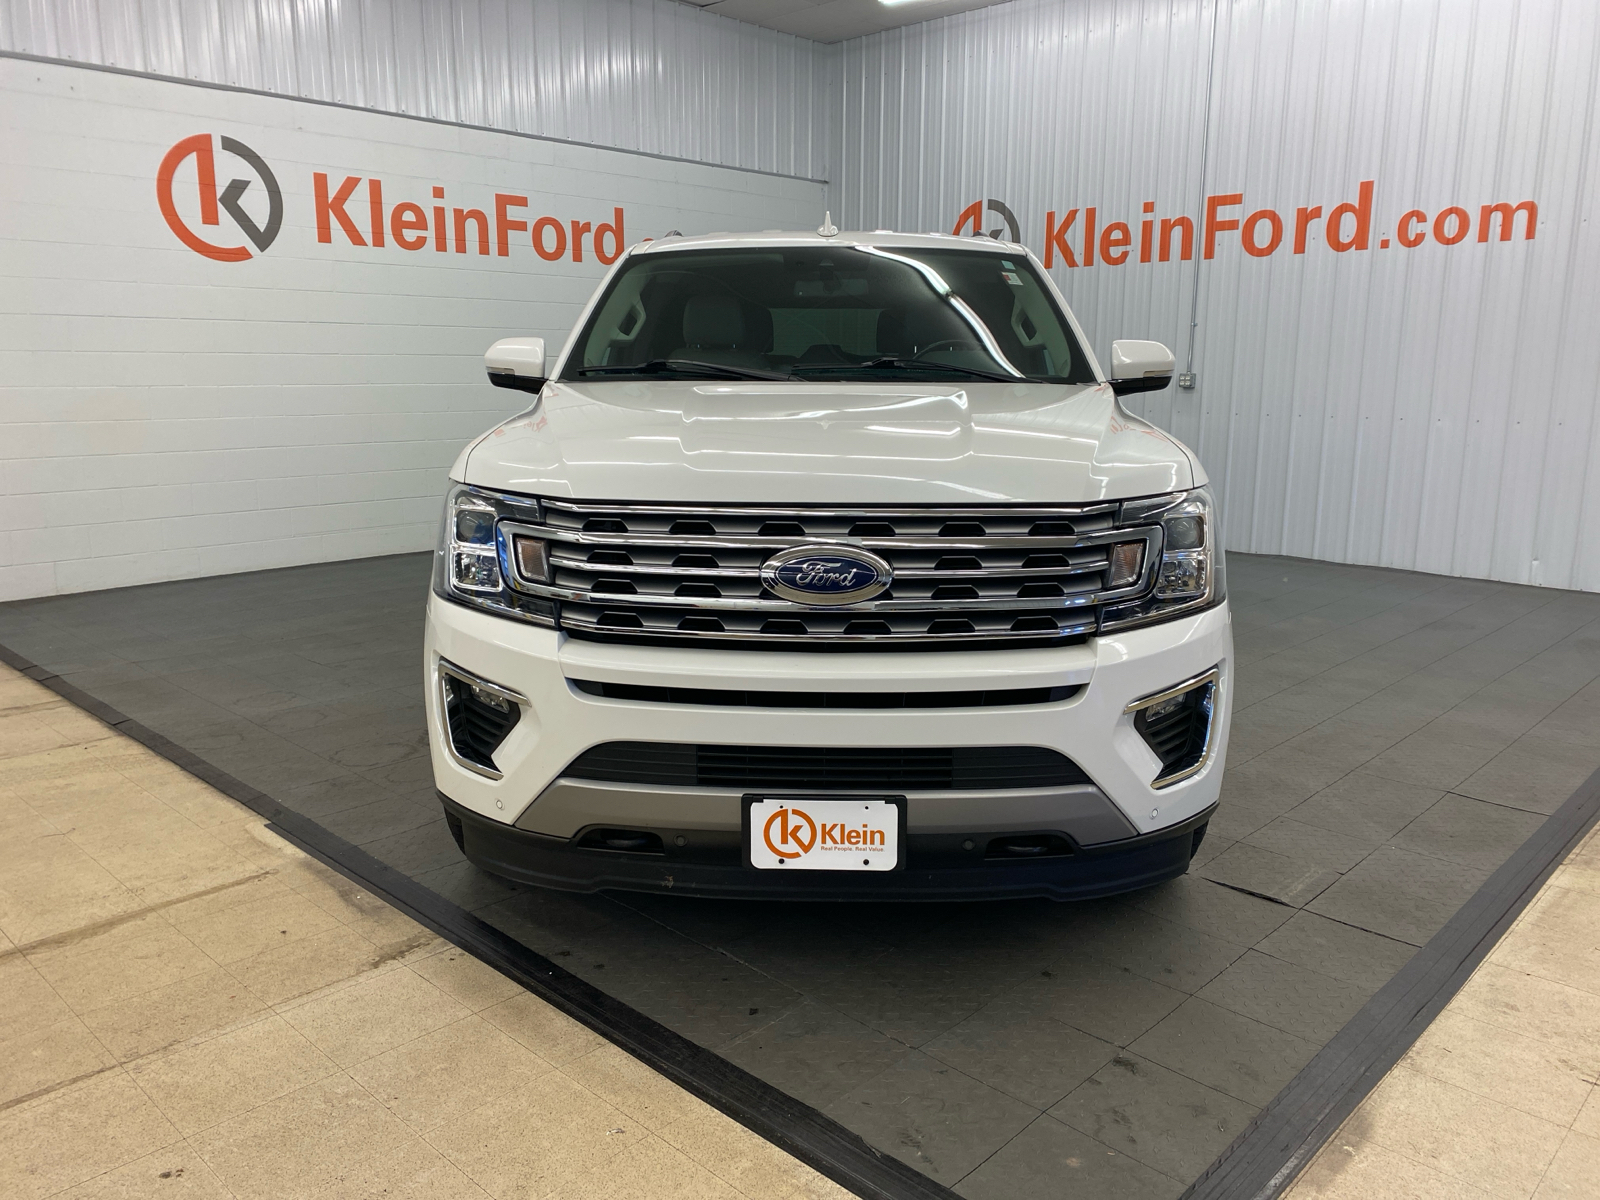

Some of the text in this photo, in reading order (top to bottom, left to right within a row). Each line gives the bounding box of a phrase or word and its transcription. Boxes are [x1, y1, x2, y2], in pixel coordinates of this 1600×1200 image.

[313, 172, 654, 266] KleinFord
[1044, 180, 1537, 270] KleinFord.com
[796, 560, 857, 587] Ford
[820, 823, 885, 846] Klein
